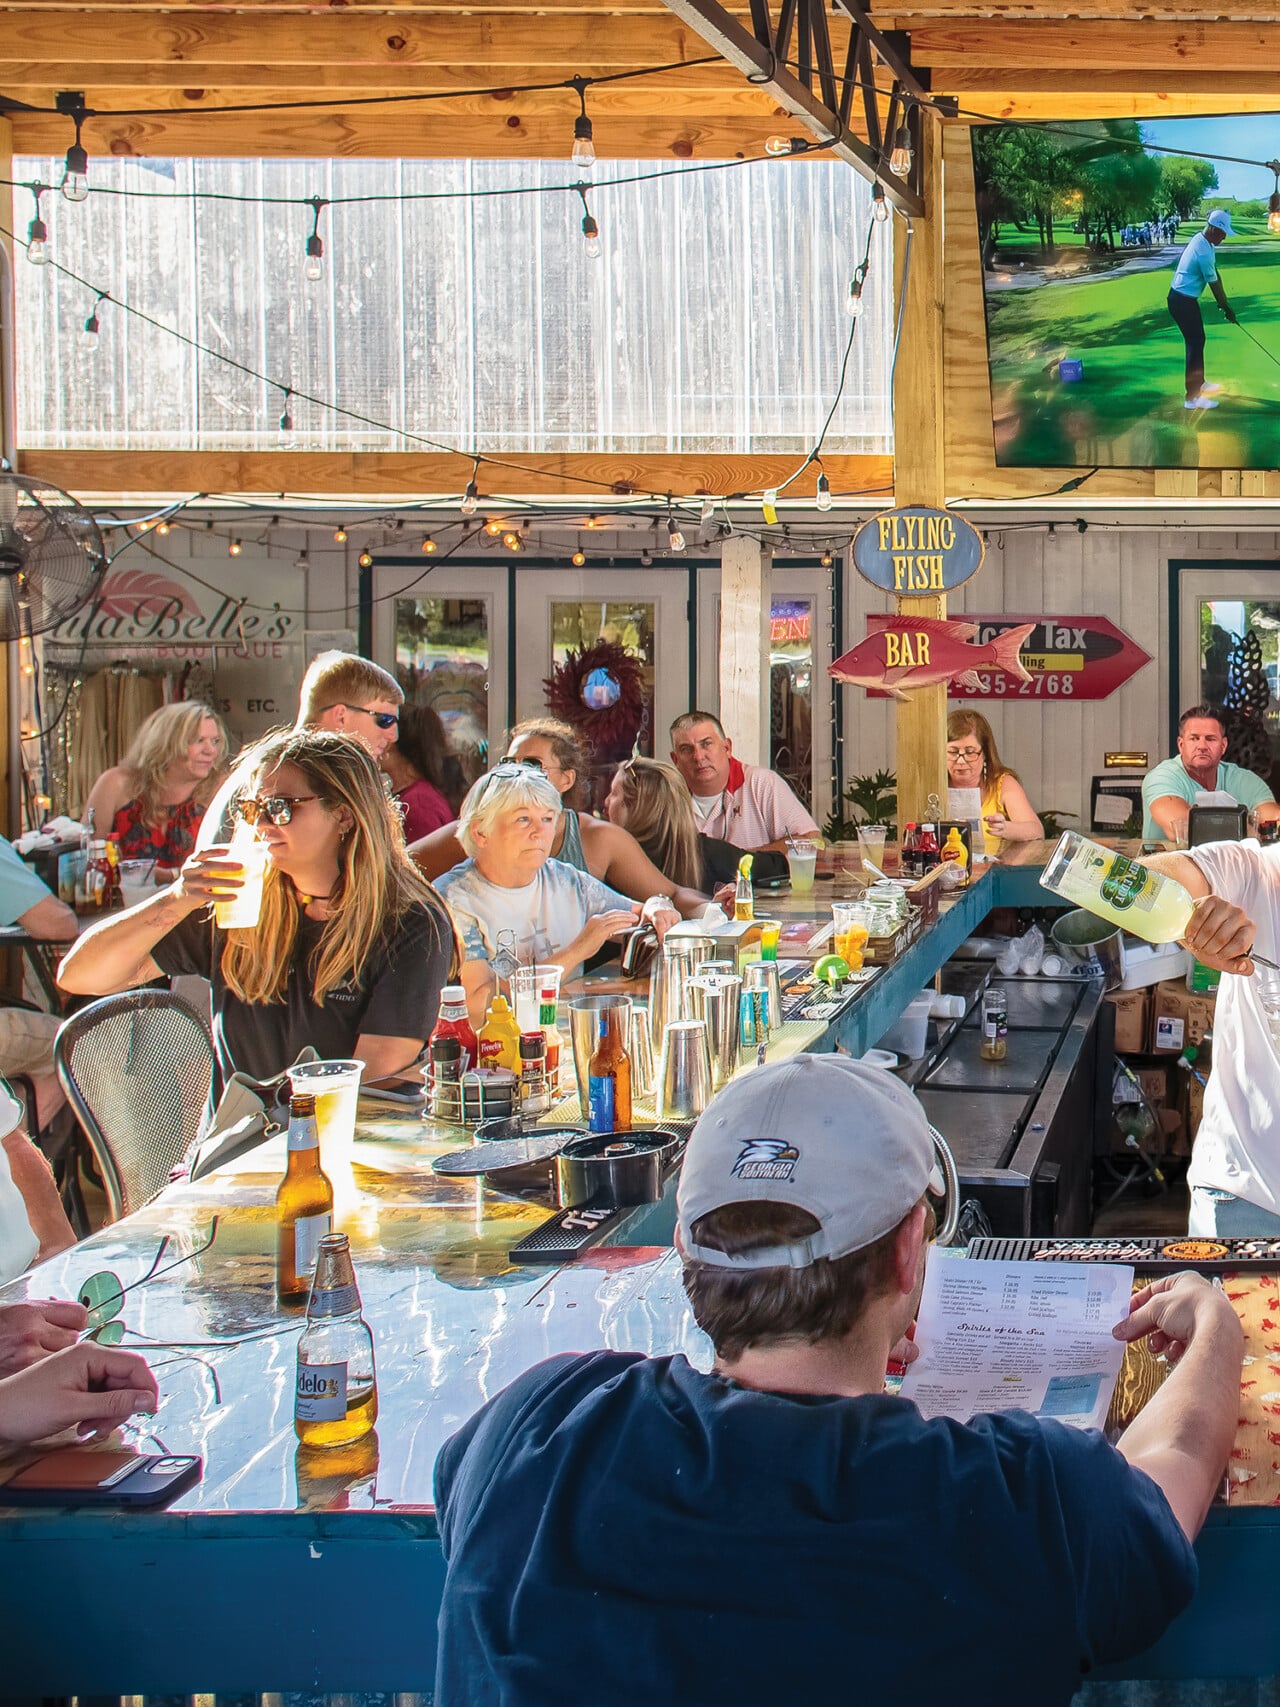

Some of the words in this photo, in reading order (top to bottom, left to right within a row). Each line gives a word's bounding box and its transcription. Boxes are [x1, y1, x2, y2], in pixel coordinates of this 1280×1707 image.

[877, 516, 957, 551] FLYING
[892, 555, 945, 590] FISH
[770, 616, 809, 640] EN
[1040, 620, 1087, 649] Tax
[885, 632, 930, 667] BAR
[247, 699, 280, 713] ETC.
[1115, 874, 1133, 904] EDDY
[739, 1170, 789, 1178] SOUTHERN
[743, 1162, 793, 1171] GEORGIA
[1053, 1242, 1139, 1250] VODKA
[957, 1323, 991, 1332] Spirits
[1007, 1327, 1023, 1335] the
[1026, 1328, 1046, 1336] Sea
[299, 1372, 327, 1393] delo
